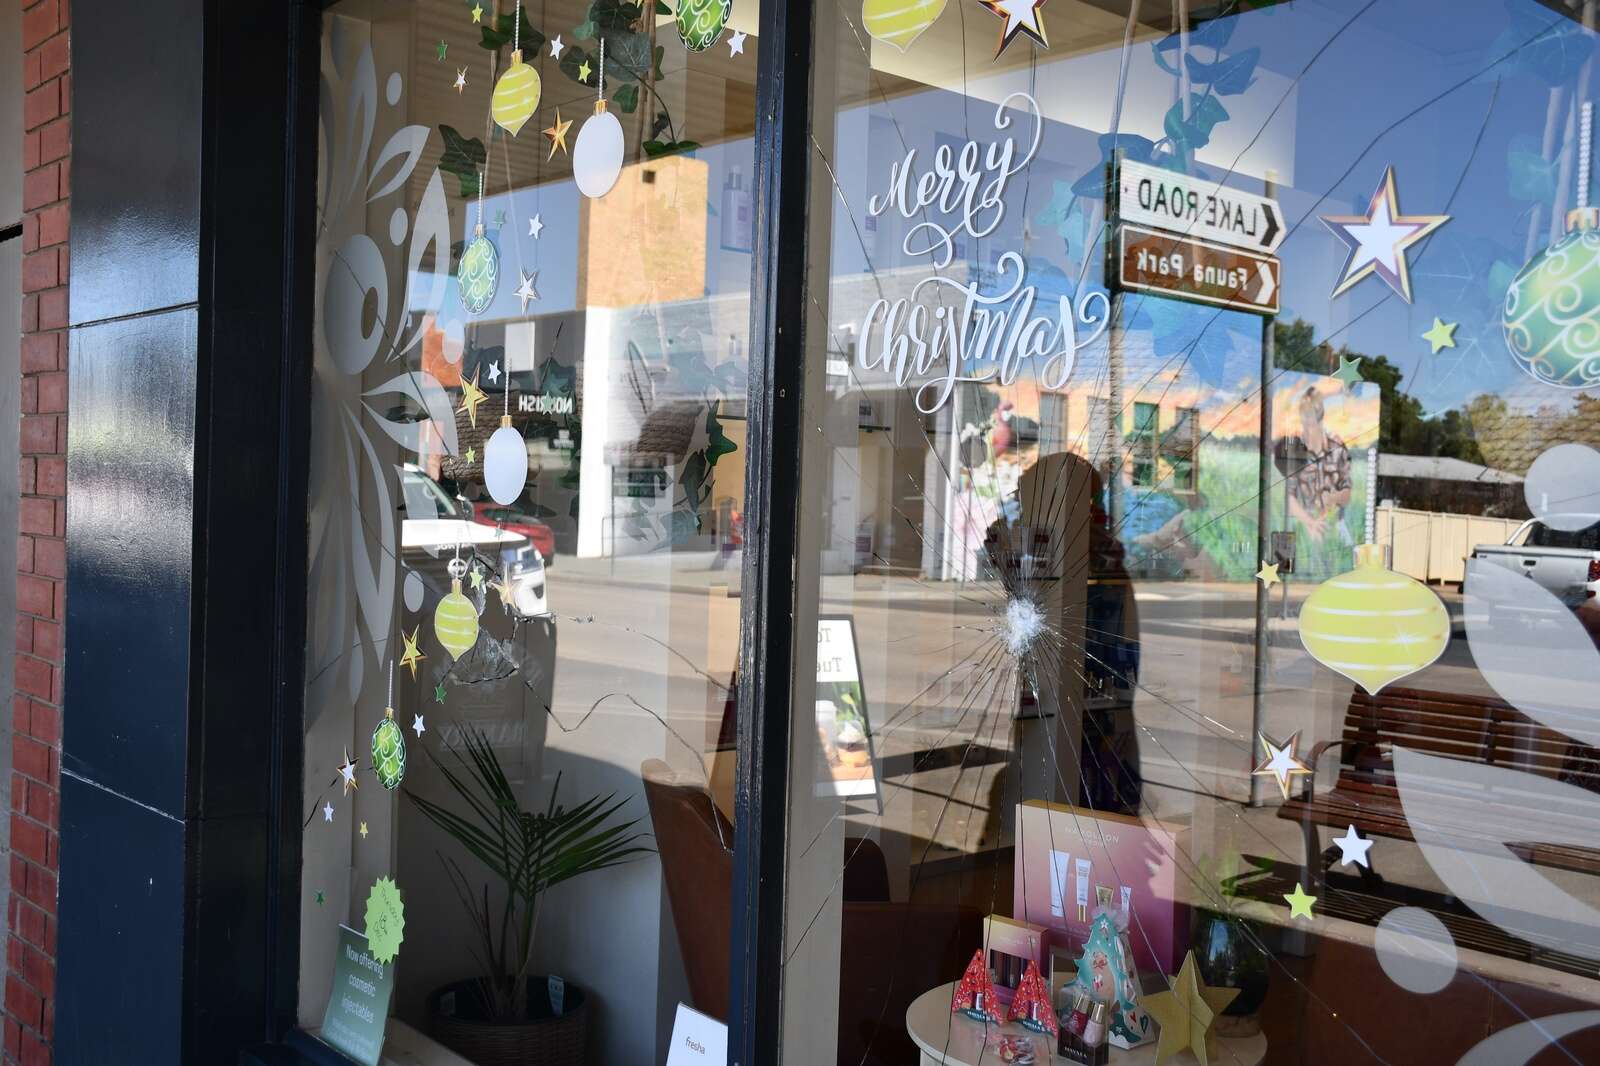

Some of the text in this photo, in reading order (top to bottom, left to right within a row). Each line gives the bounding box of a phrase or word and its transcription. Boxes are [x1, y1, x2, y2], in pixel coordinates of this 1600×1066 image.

[869, 92, 1043, 268] Merry
[859, 251, 1110, 414] Christmas
[346, 943, 384, 979] Now offering
[348, 973, 377, 998] cosmetic
[685, 1036, 706, 1055] fresha
